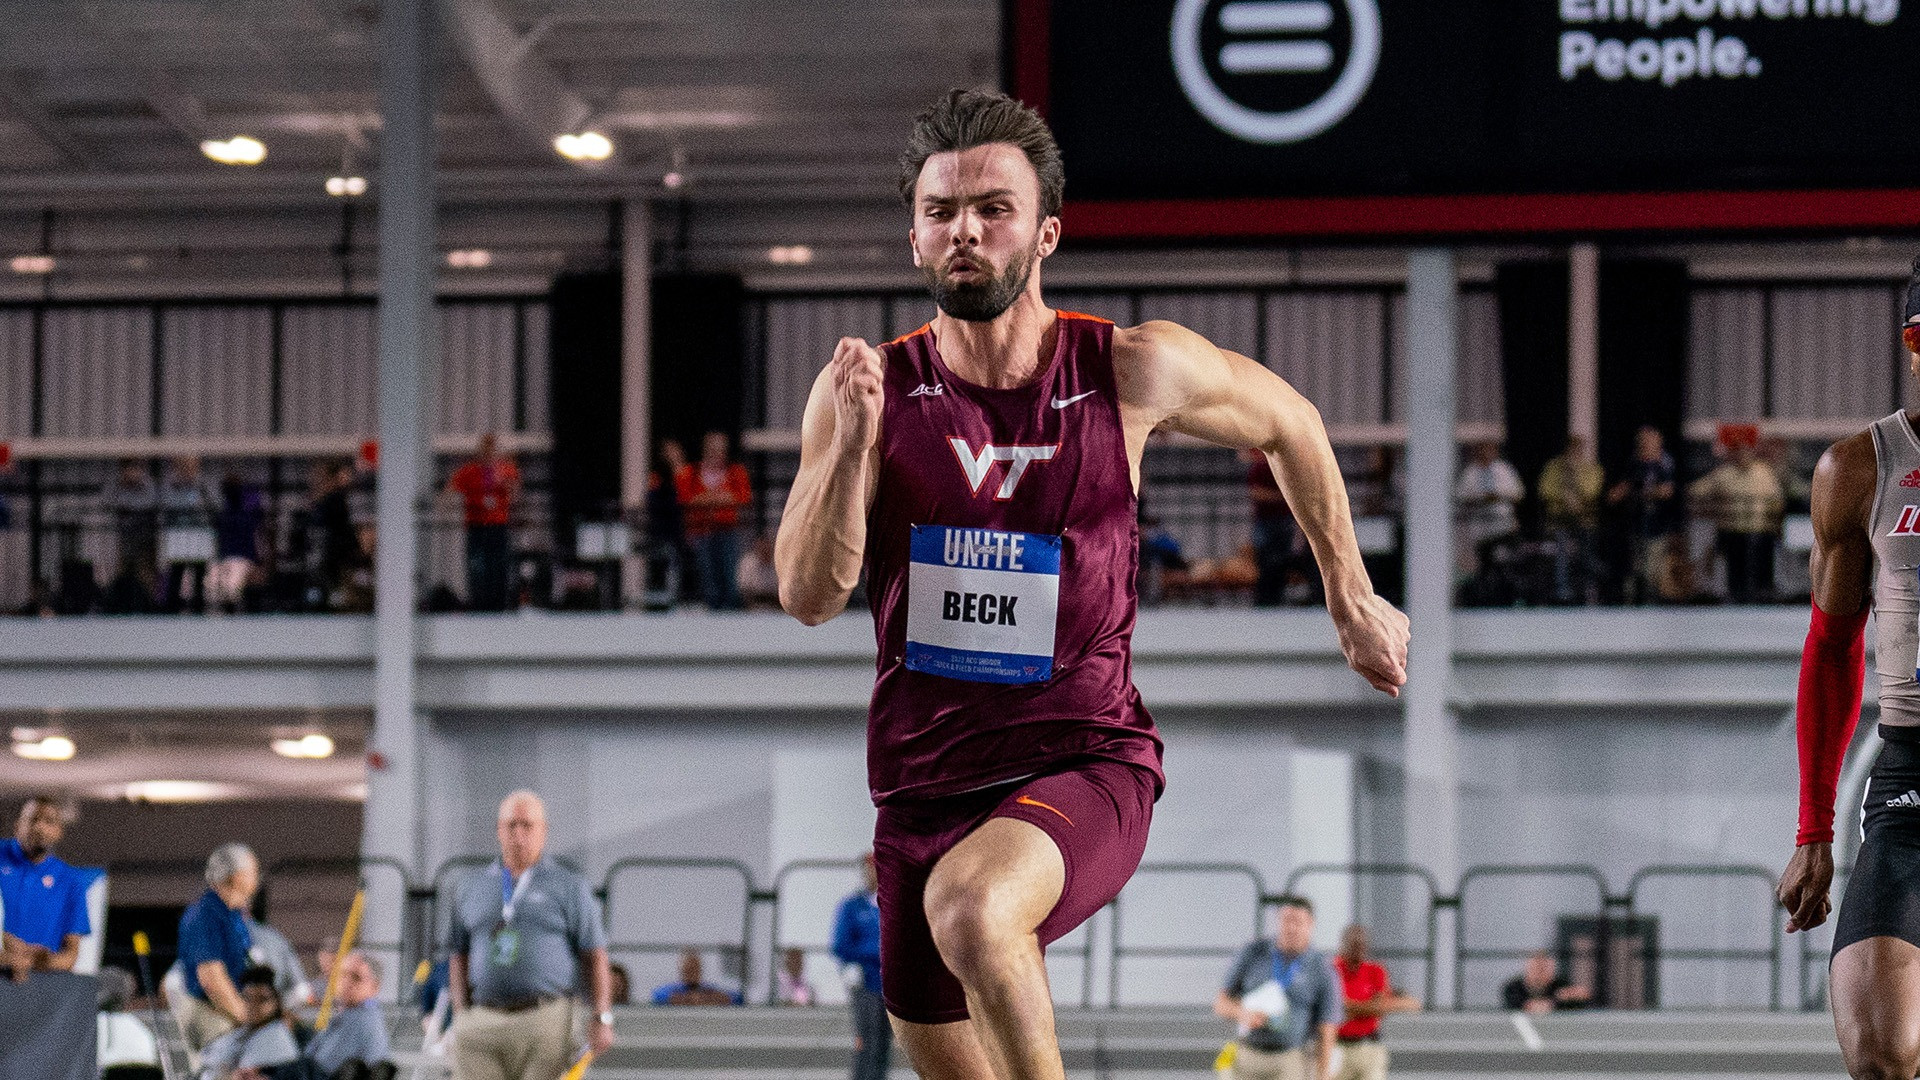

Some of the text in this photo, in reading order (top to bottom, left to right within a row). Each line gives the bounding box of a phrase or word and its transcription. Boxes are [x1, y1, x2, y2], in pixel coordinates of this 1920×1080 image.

[1560, 28, 1762, 86] People.
[946, 435, 1062, 500] VT
[944, 528, 1025, 570] UNITE
[943, 590, 1018, 626] BECK
